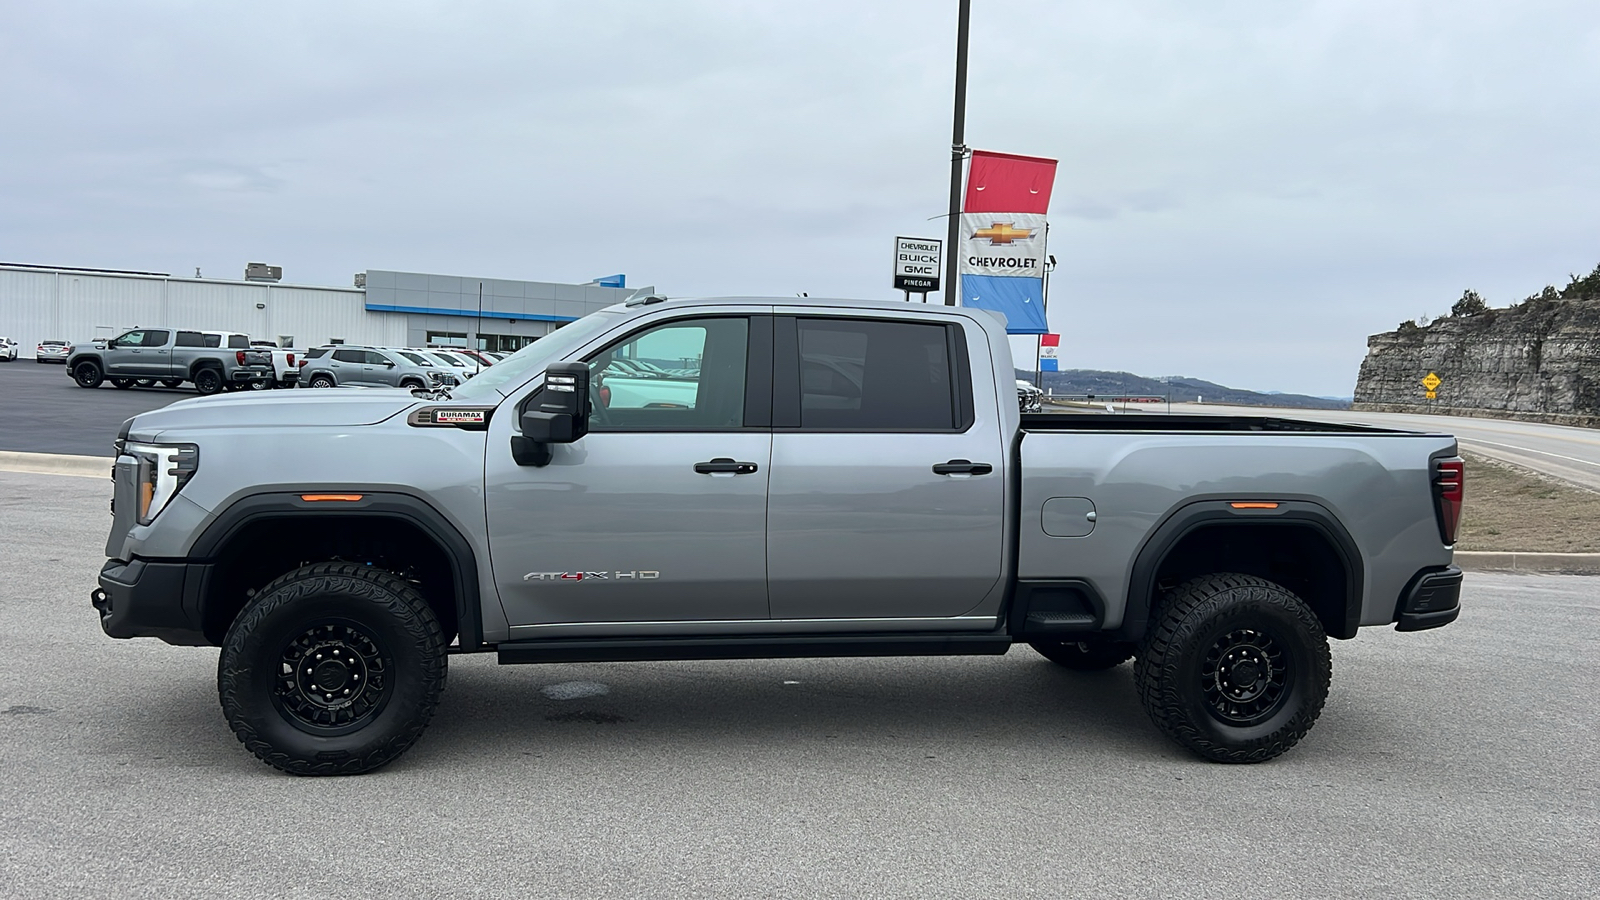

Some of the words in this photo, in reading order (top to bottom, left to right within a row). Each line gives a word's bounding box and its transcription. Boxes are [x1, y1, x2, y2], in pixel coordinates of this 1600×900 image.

[900, 242, 938, 251] CHEVROLET
[899, 253, 938, 263] BUICK
[968, 256, 1036, 268] CHEVROLET
[904, 265, 933, 274] GMC
[903, 279, 932, 287] PINEGAR
[523, 571, 608, 582] AT4X
[615, 571, 660, 580] HD
